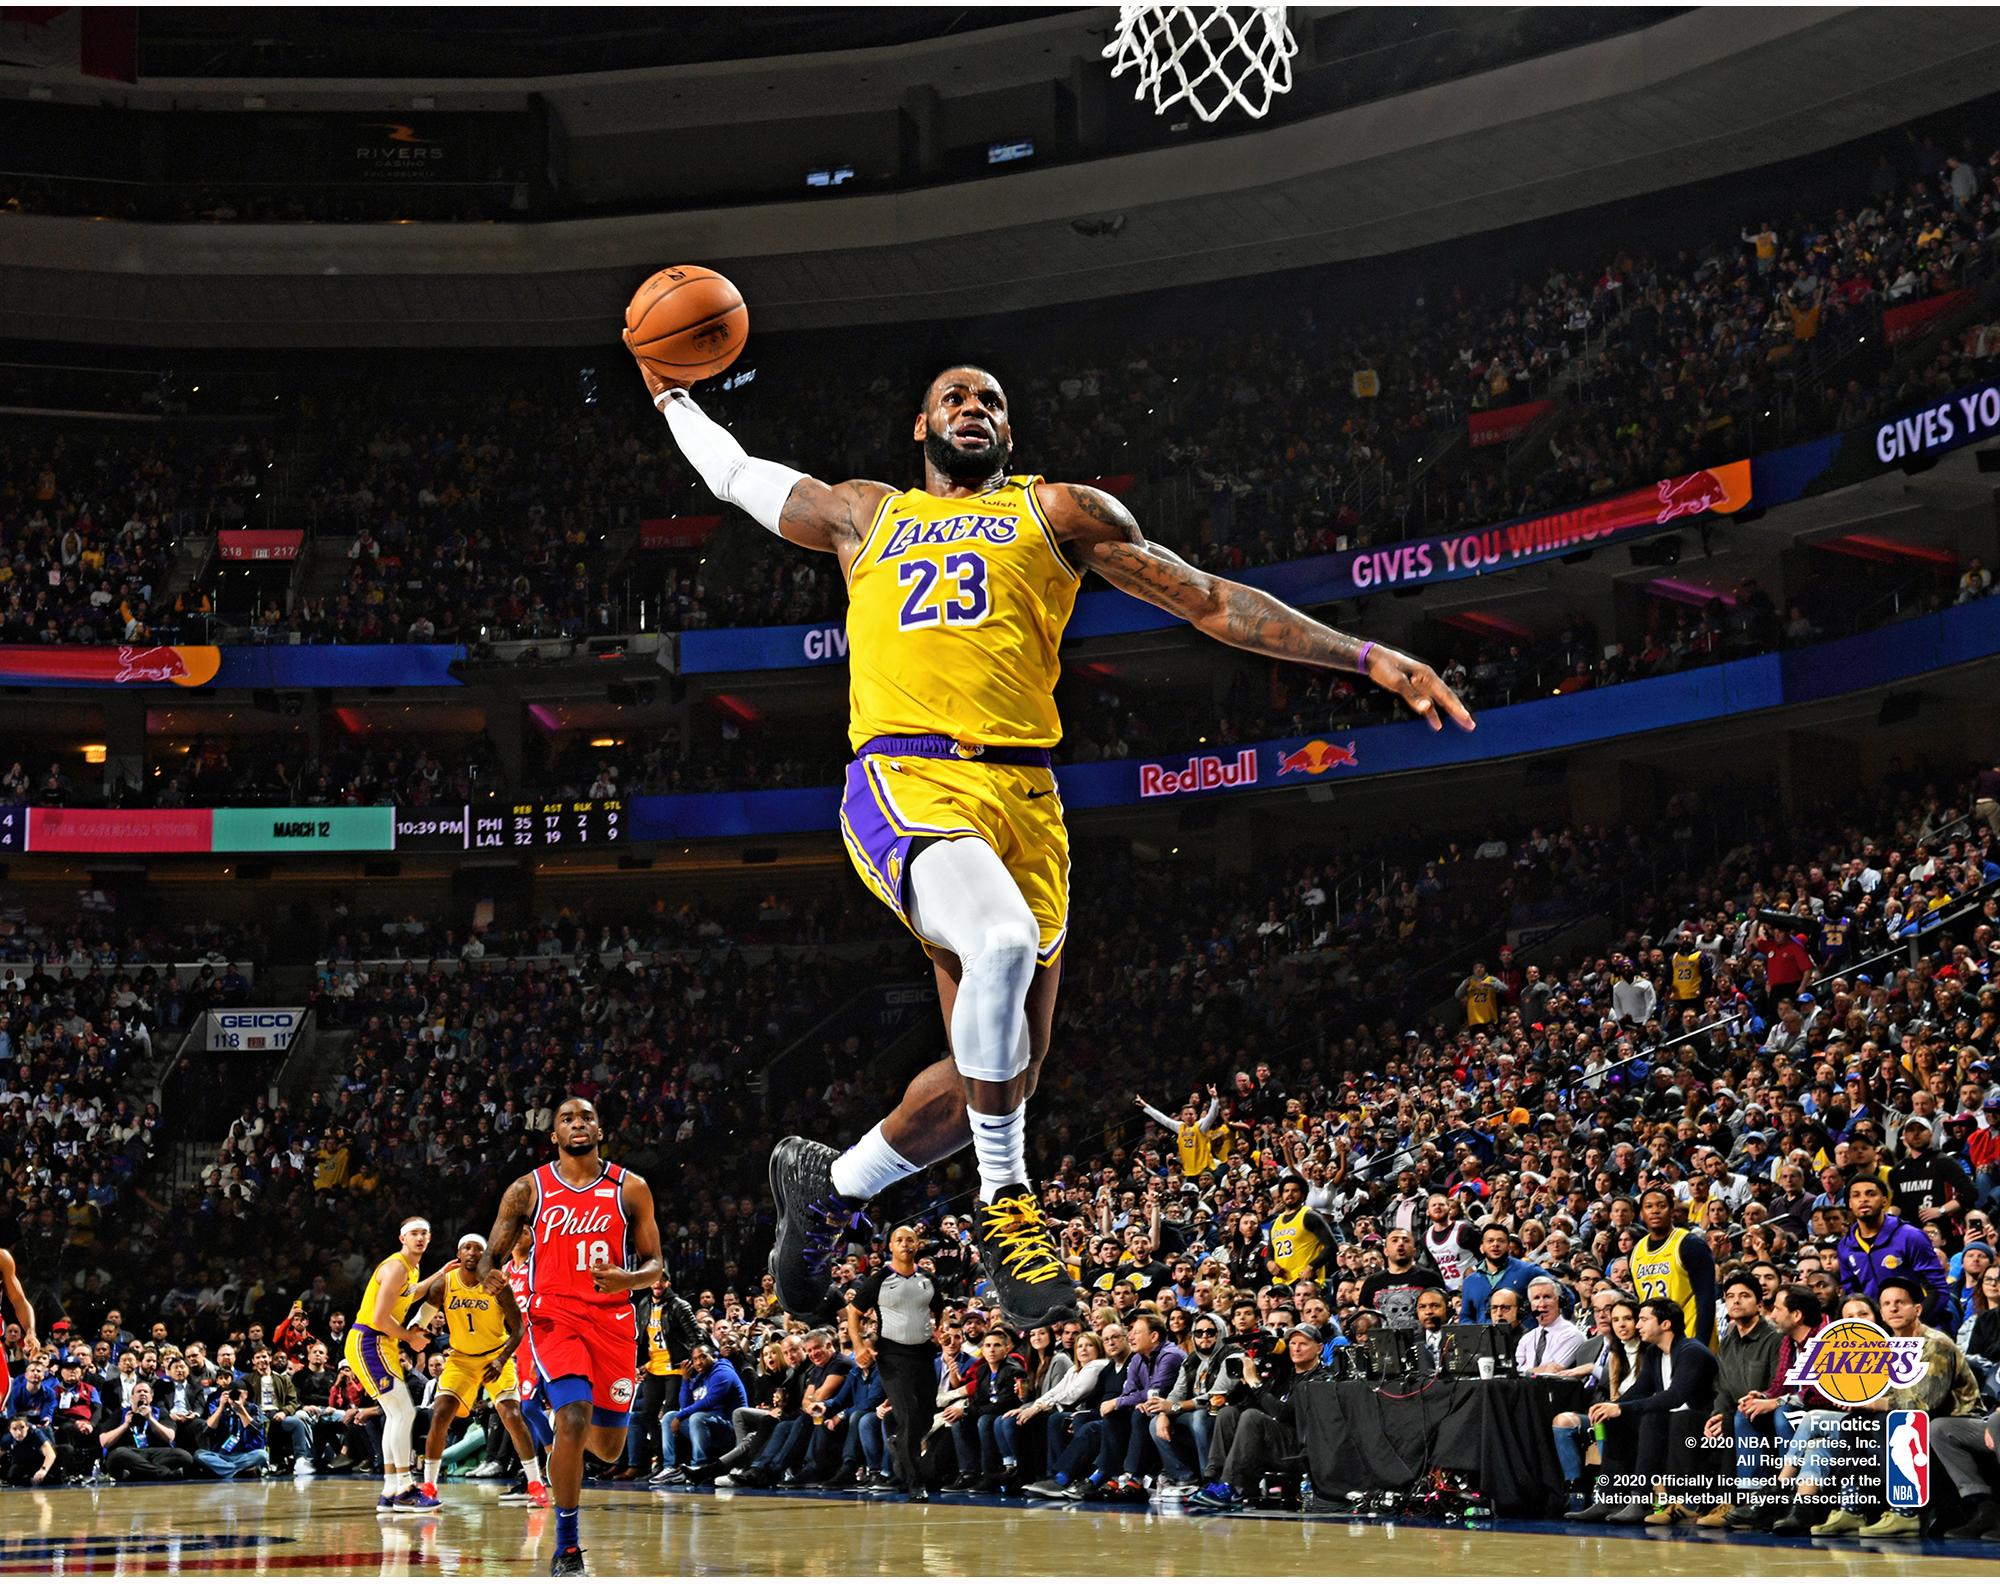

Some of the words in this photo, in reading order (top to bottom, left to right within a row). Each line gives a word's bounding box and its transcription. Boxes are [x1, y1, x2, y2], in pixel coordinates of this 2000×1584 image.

[356, 148, 443, 159] RIVERS
[1876, 404, 1954, 463] GIVES
[874, 514, 1020, 565] LAKERS
[221, 547, 242, 557] 218
[1352, 544, 1432, 587] GIVES
[1441, 531, 1501, 572] YOU
[898, 551, 990, 632] 23
[543, 803, 562, 813] AST
[573, 802, 592, 811] BLK
[603, 801, 622, 810] STL
[2, 814, 13, 827] 4
[273, 822, 315, 837] MARCH
[318, 822, 331, 837] 12
[397, 822, 436, 834] 10:39
[439, 821, 464, 834] PM
[477, 818, 503, 831] PHI
[514, 817, 532, 829] 35
[545, 816, 560, 828] 17
[577, 815, 588, 827] 2
[608, 813, 618, 825] 9
[1, 833, 12, 845] 4
[476, 833, 504, 847] LAL
[514, 832, 532, 845] 32
[545, 831, 561, 844] 19
[579, 830, 587, 842] 1
[608, 828, 618, 840] 9
[221, 1015, 293, 1028] GEICO
[214, 1033, 240, 1048] 118
[541, 1205, 612, 1244] Phila
[576, 1240, 609, 1271] 18
[1275, 1239, 1294, 1258] 23
[1440, 1264, 1461, 1280] 25
[1636, 1261, 1671, 1280] LAKERS
[1641, 1280, 1667, 1300] 23
[448, 1295, 489, 1311] LAKERS
[466, 1313, 475, 1333] 1
